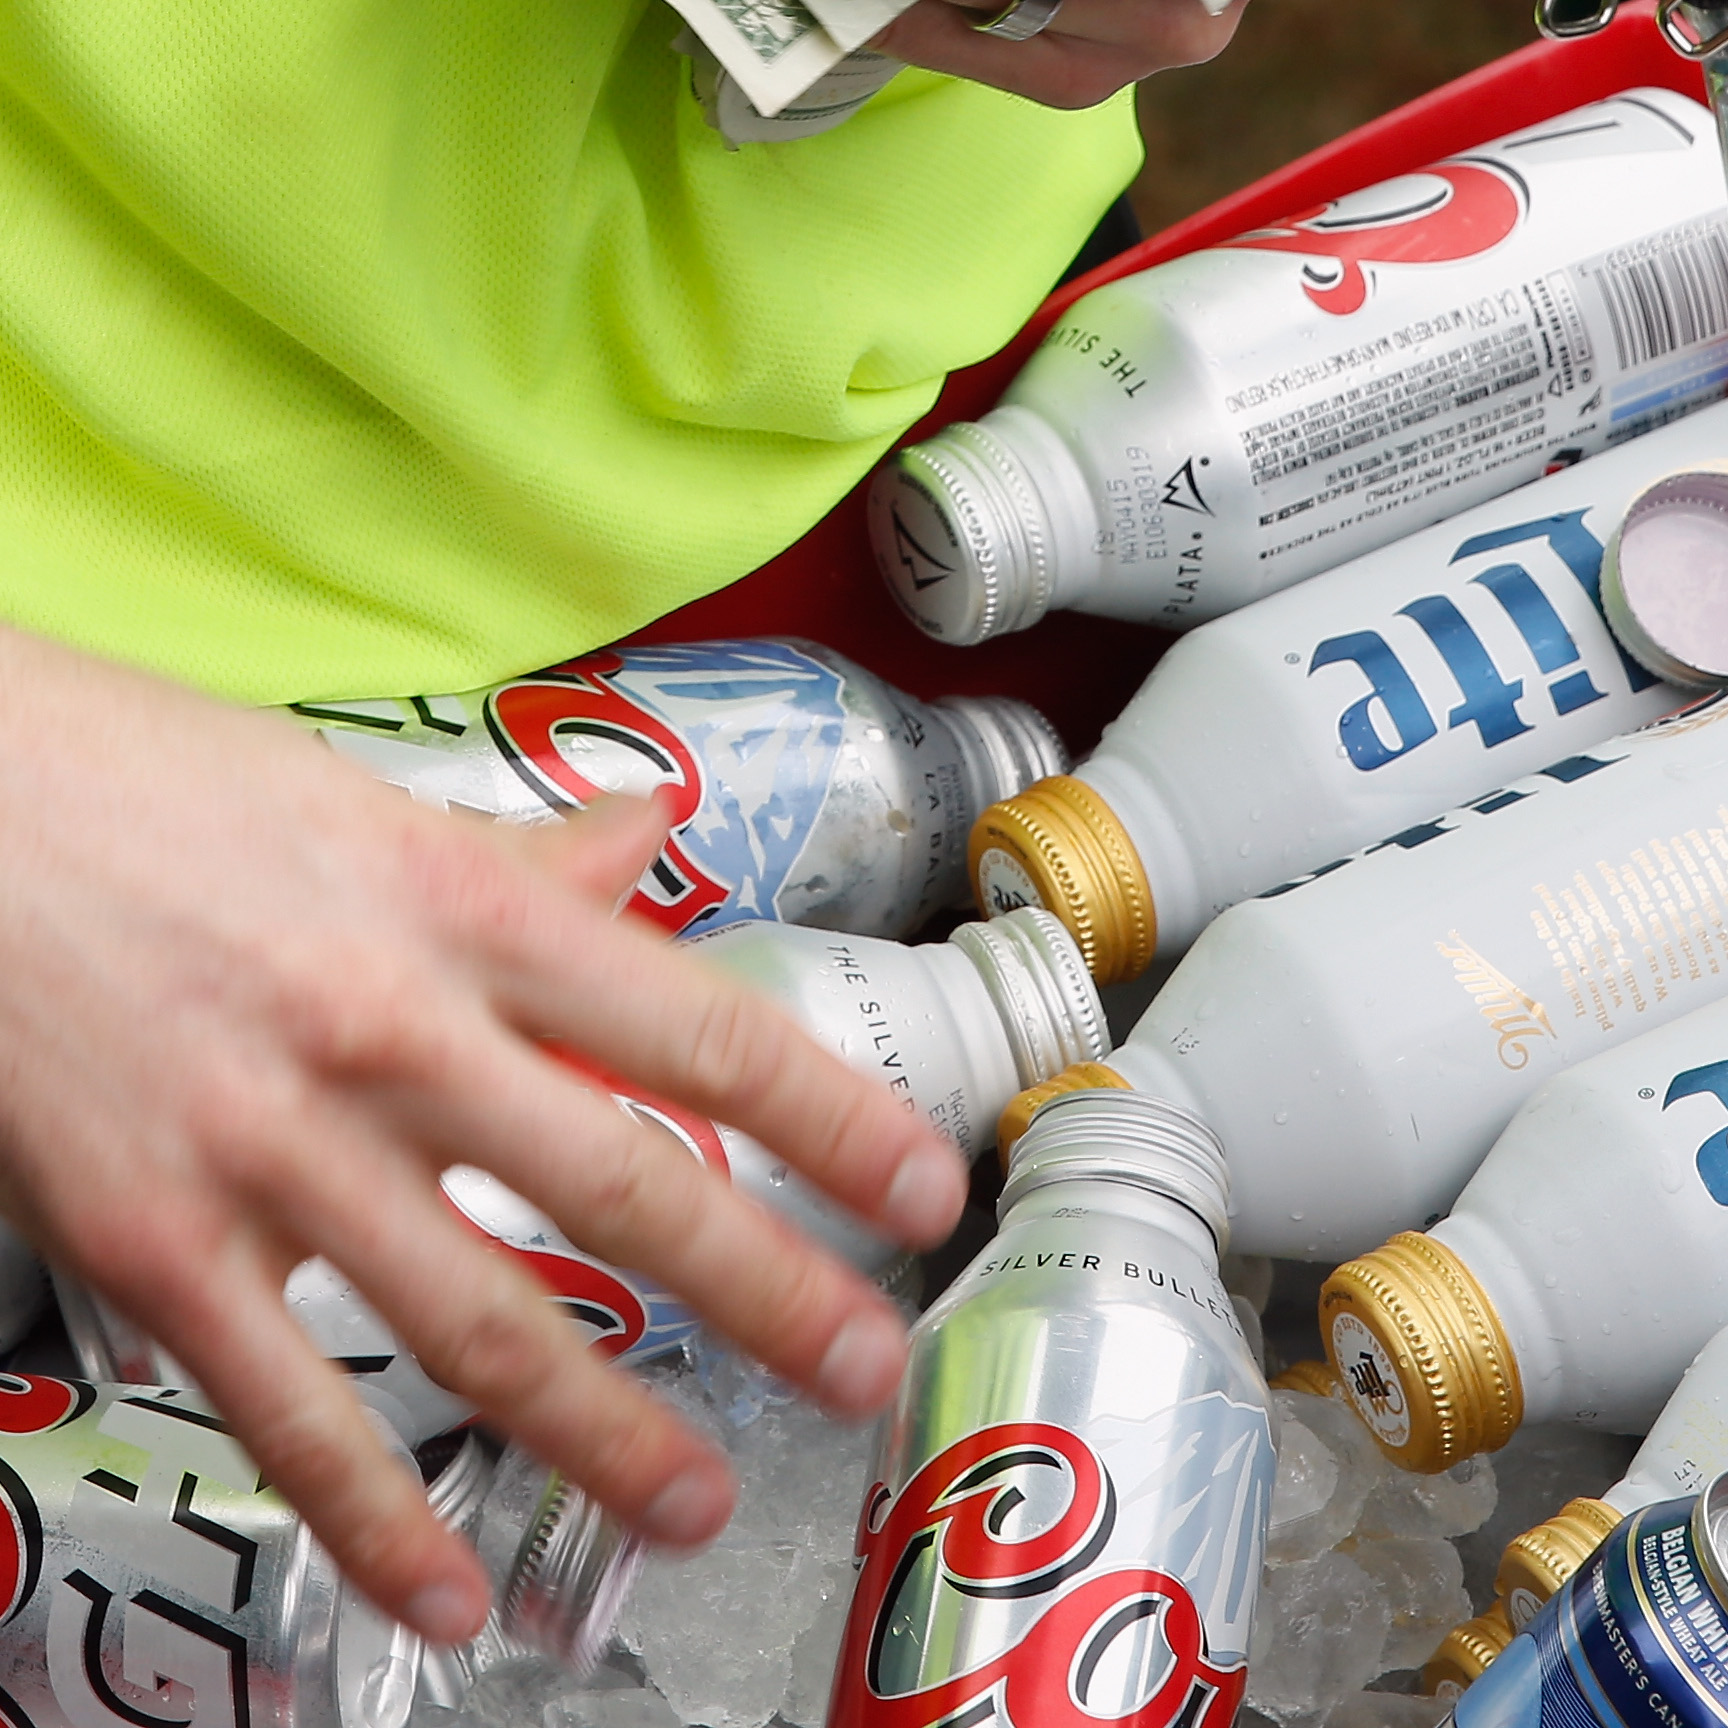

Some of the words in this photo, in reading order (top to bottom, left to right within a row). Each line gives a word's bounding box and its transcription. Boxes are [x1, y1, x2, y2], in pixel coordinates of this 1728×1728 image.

[1105, 345, 1150, 399] THE
[827, 945, 869, 991] THE
[1434, 928, 1560, 1071] Miller
[978, 1253, 1102, 1278] SILVER
[1641, 1535, 1681, 1620] BELGIAN-STYLE
[1671, 1614, 1707, 1664] WHEAT
[1661, 1524, 1705, 1604] BELGIAN
[1591, 1558, 1648, 1692] BREWMASTER'S
